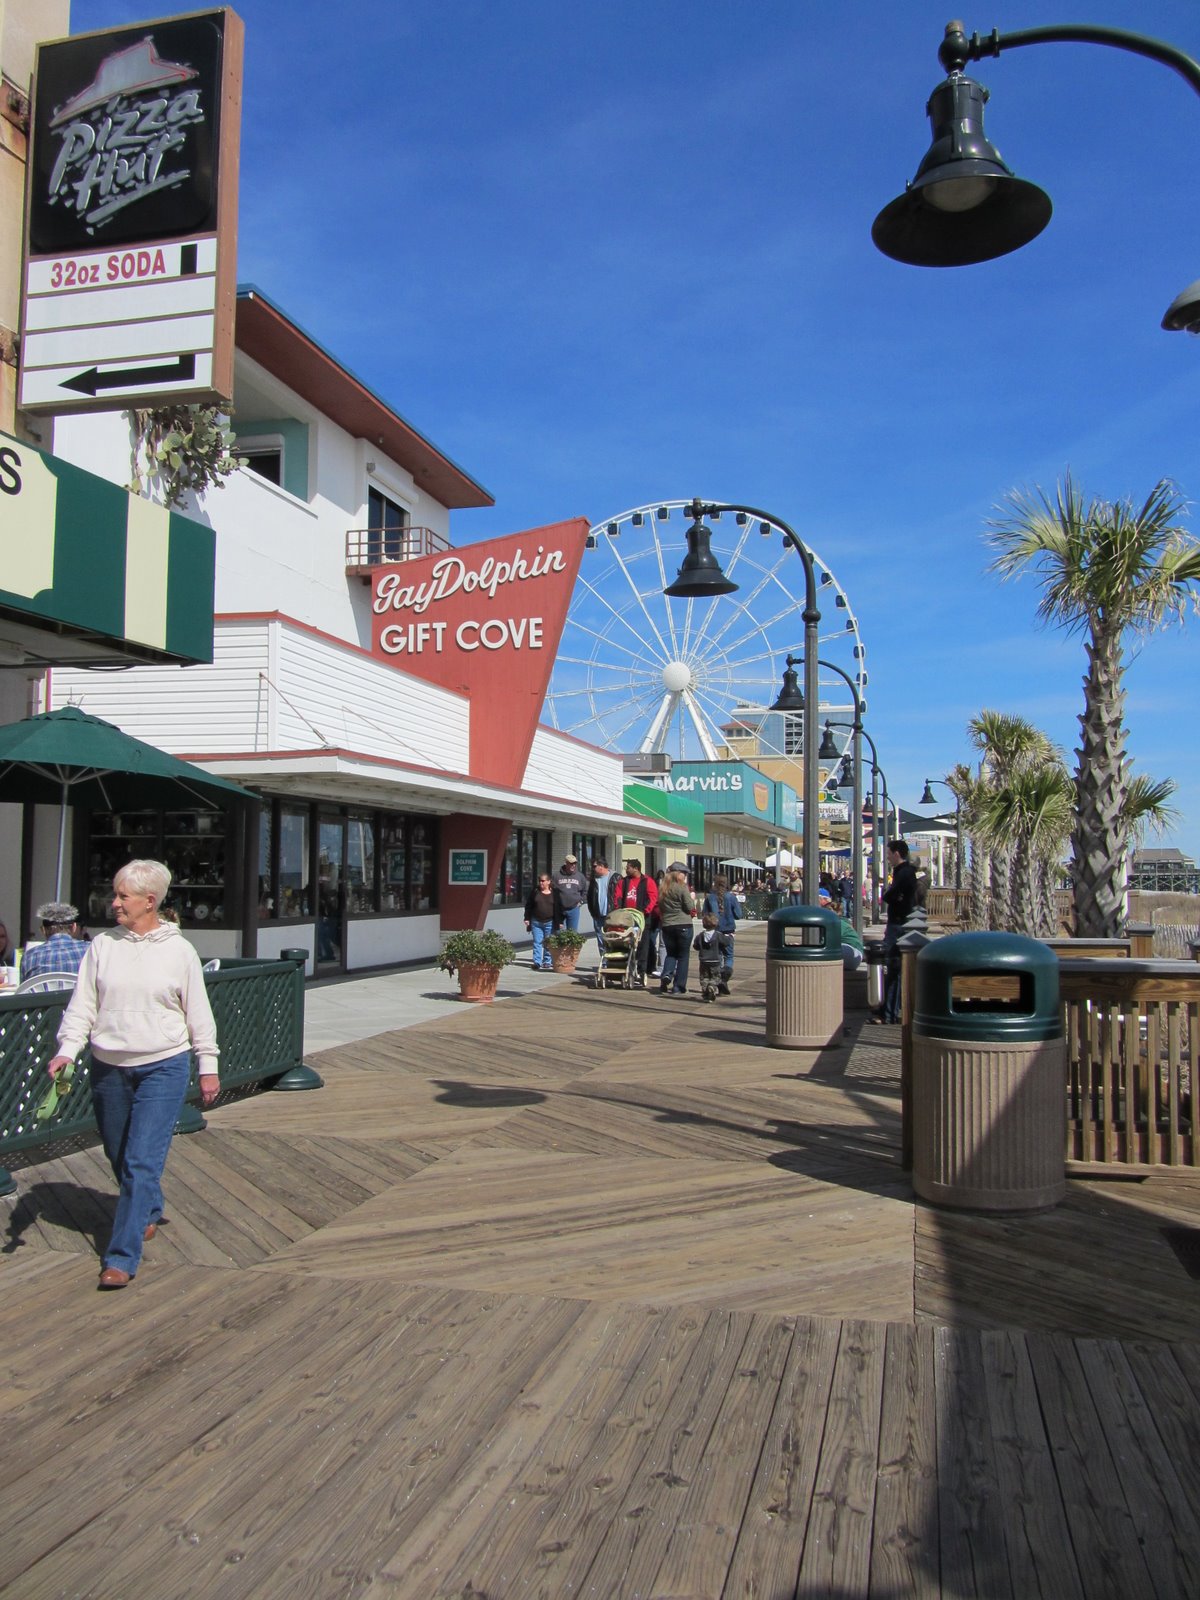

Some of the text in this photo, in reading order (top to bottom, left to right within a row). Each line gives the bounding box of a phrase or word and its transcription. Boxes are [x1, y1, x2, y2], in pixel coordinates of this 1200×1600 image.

[49, 91, 204, 195] Pizza
[75, 132, 186, 210] Hut
[50, 249, 166, 288] 32oz SODA
[373, 546, 566, 613] Gay Dolphin
[380, 617, 543, 653] GIFT COVE
